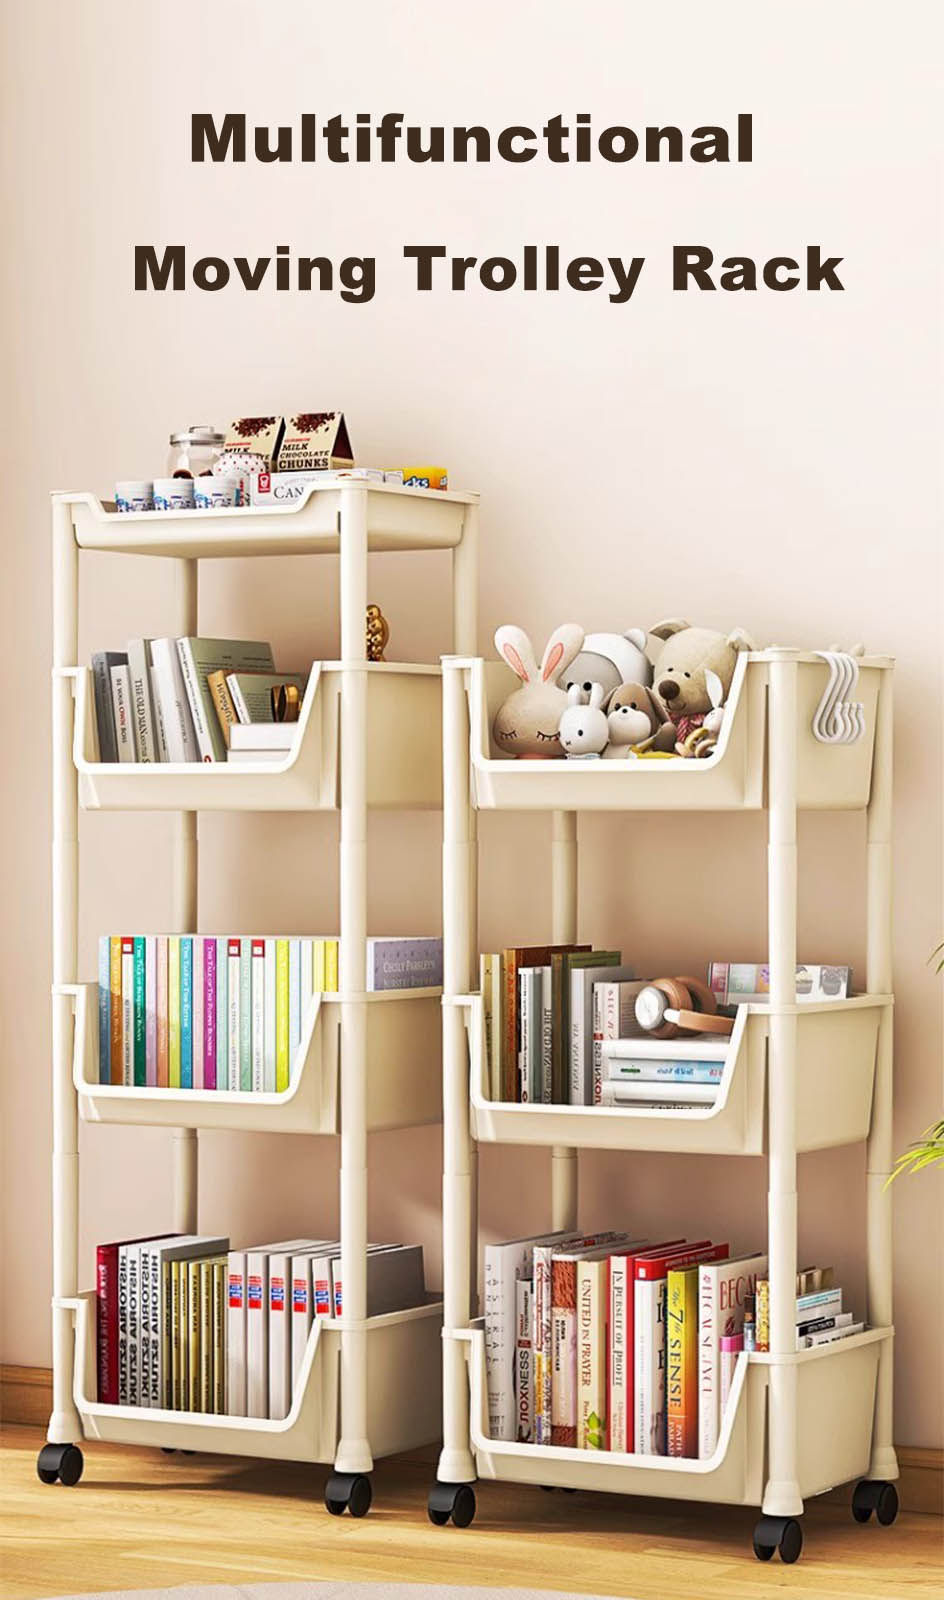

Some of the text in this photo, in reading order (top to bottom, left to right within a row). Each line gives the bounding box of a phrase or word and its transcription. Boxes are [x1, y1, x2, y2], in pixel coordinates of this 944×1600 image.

[280, 450, 330, 458] CHOCOLATE
[282, 442, 309, 451] MILK
[279, 458, 329, 468] CHUNKS
[134, 678, 143, 696] THE
[136, 696, 146, 716] OLD
[138, 716, 148, 735] MAN
[582, 1278, 592, 1386] UNITED IN PRAYER
[613, 1270, 624, 1386] IN PURSUIT OF PROFIT
[670, 1338, 682, 1408] SENSE
